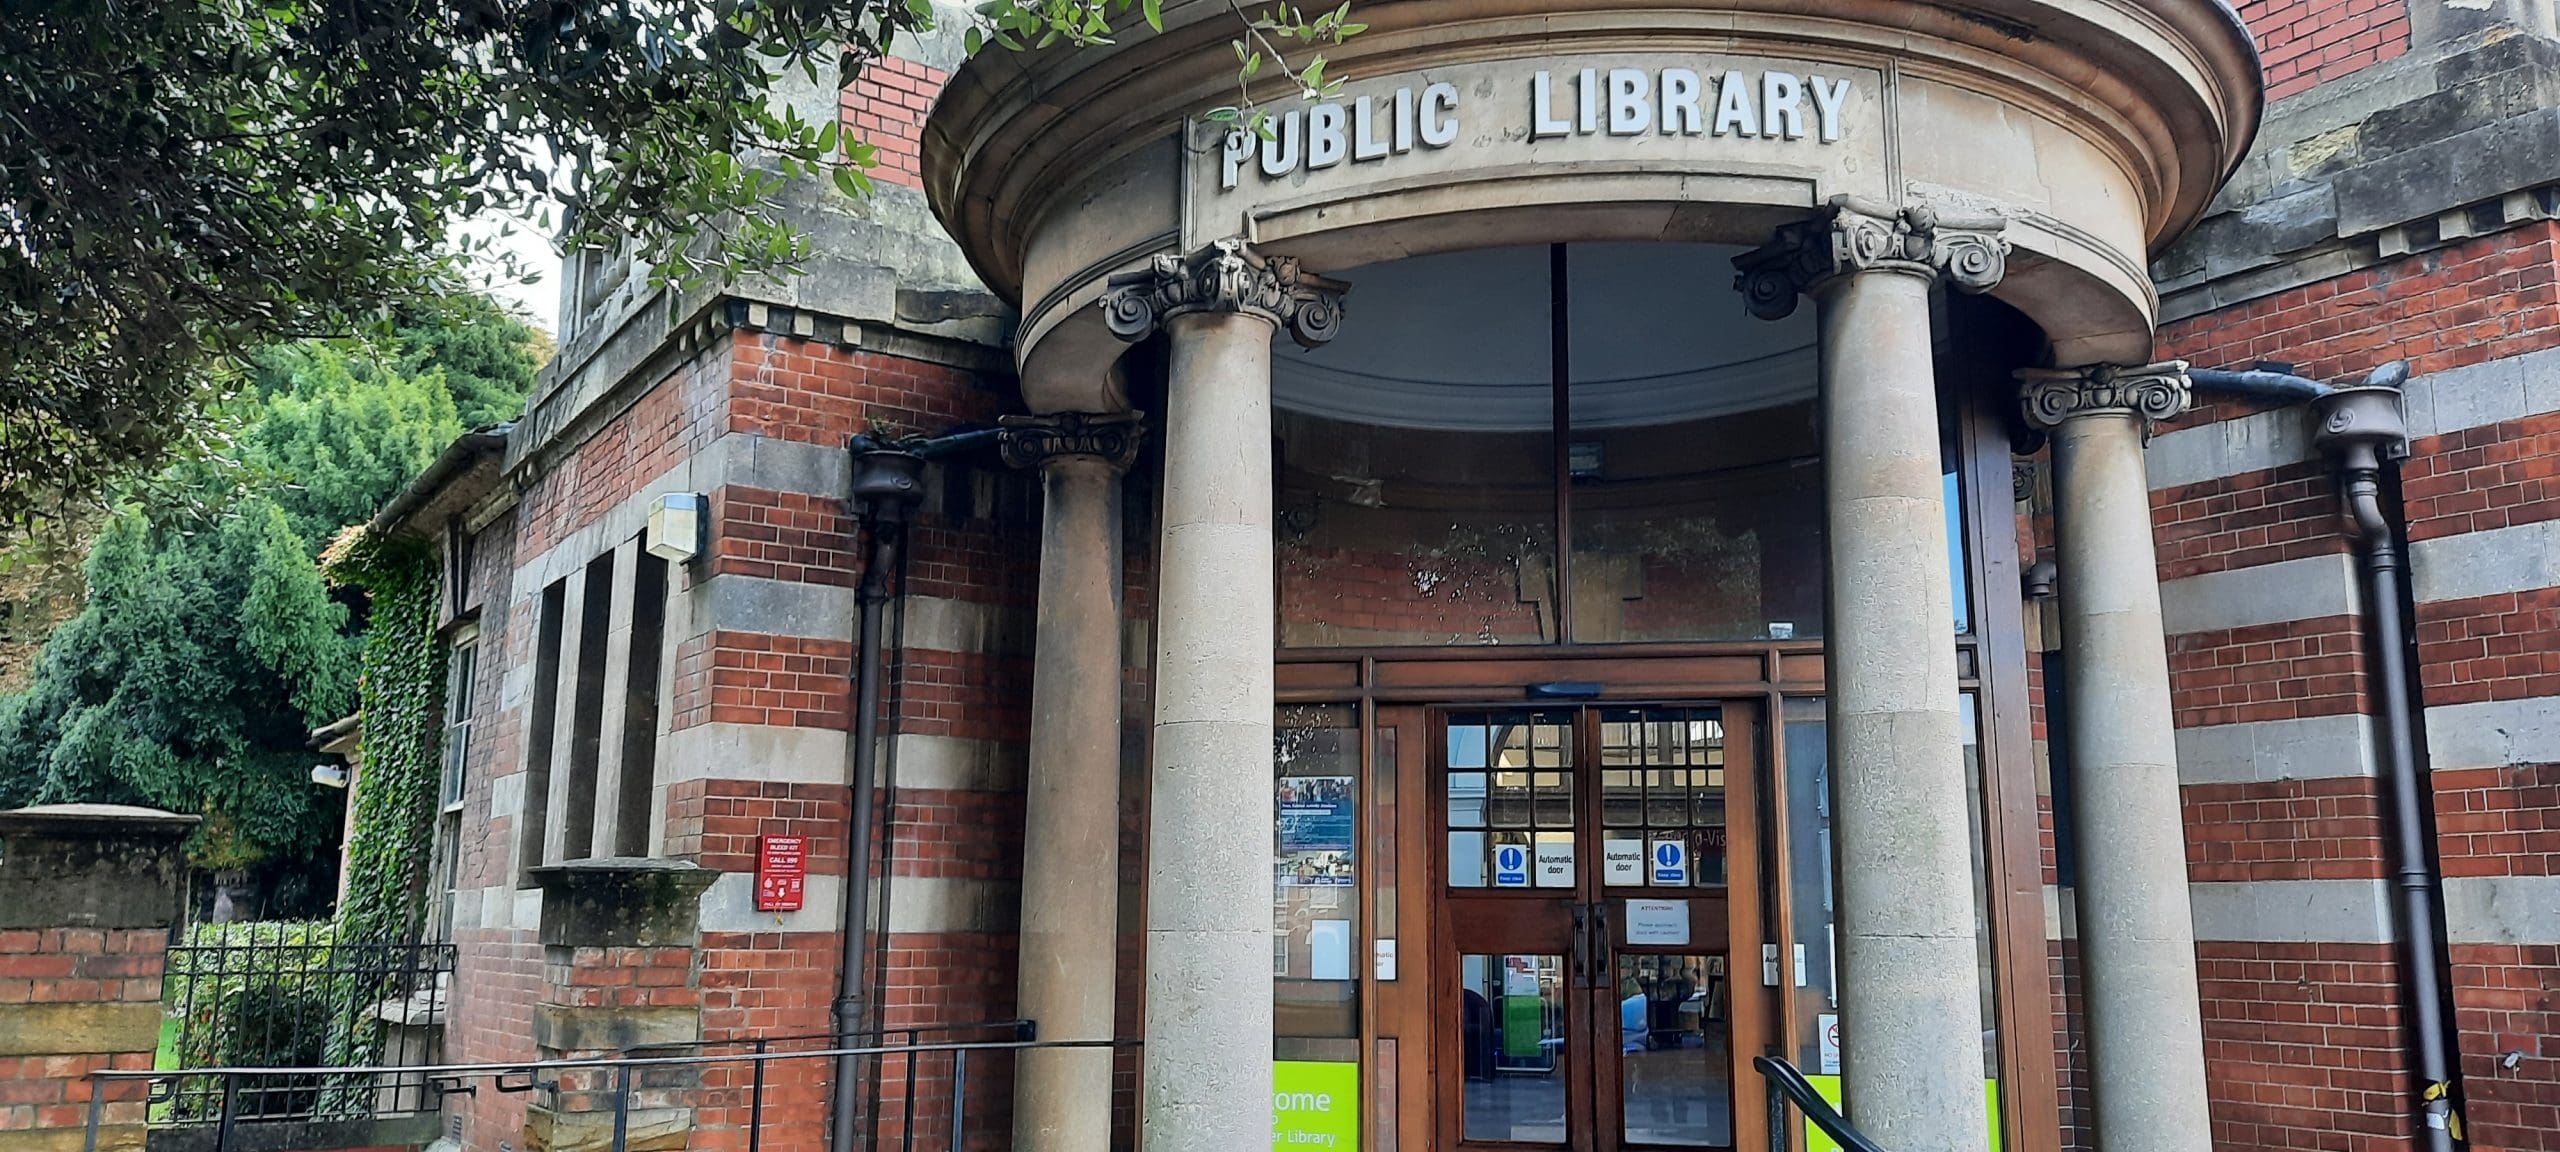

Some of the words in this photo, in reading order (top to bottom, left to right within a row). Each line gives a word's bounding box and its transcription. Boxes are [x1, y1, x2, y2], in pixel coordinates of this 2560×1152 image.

[1221, 81, 1460, 190] PUBLIC
[1533, 67, 1852, 145] LIBRARY
[1538, 854, 1573, 865] Automatic
[1606, 851, 1641, 861] Automatic
[1547, 865, 1564, 874] door
[1615, 862, 1633, 872] door
[1287, 1128, 1336, 1148] Library
